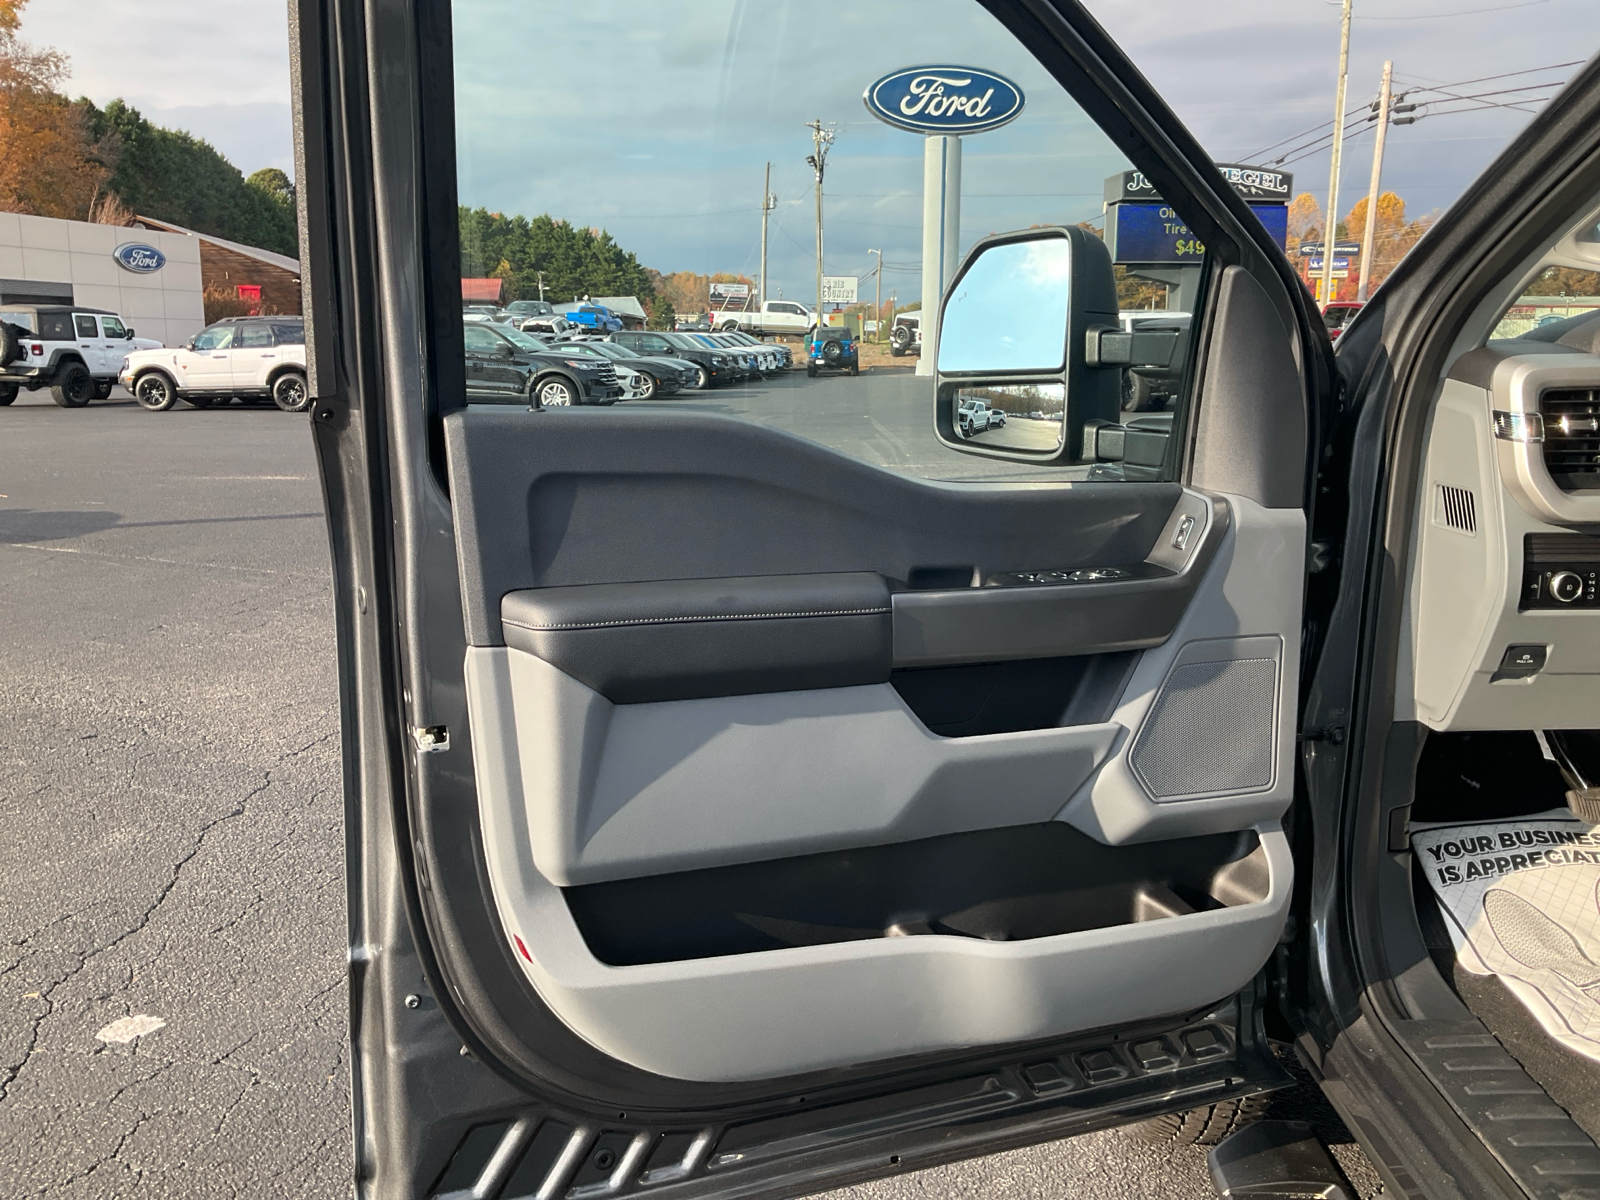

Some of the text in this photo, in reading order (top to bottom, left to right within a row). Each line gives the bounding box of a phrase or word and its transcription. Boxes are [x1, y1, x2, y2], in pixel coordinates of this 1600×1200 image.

[900, 76, 995, 117] Ford
[1163, 223, 1187, 234] Tire
[130, 249, 158, 267] Ford
[1426, 830, 1600, 862] YOUR BUSINES
[1436, 849, 1600, 885] IS APPRECIAT
